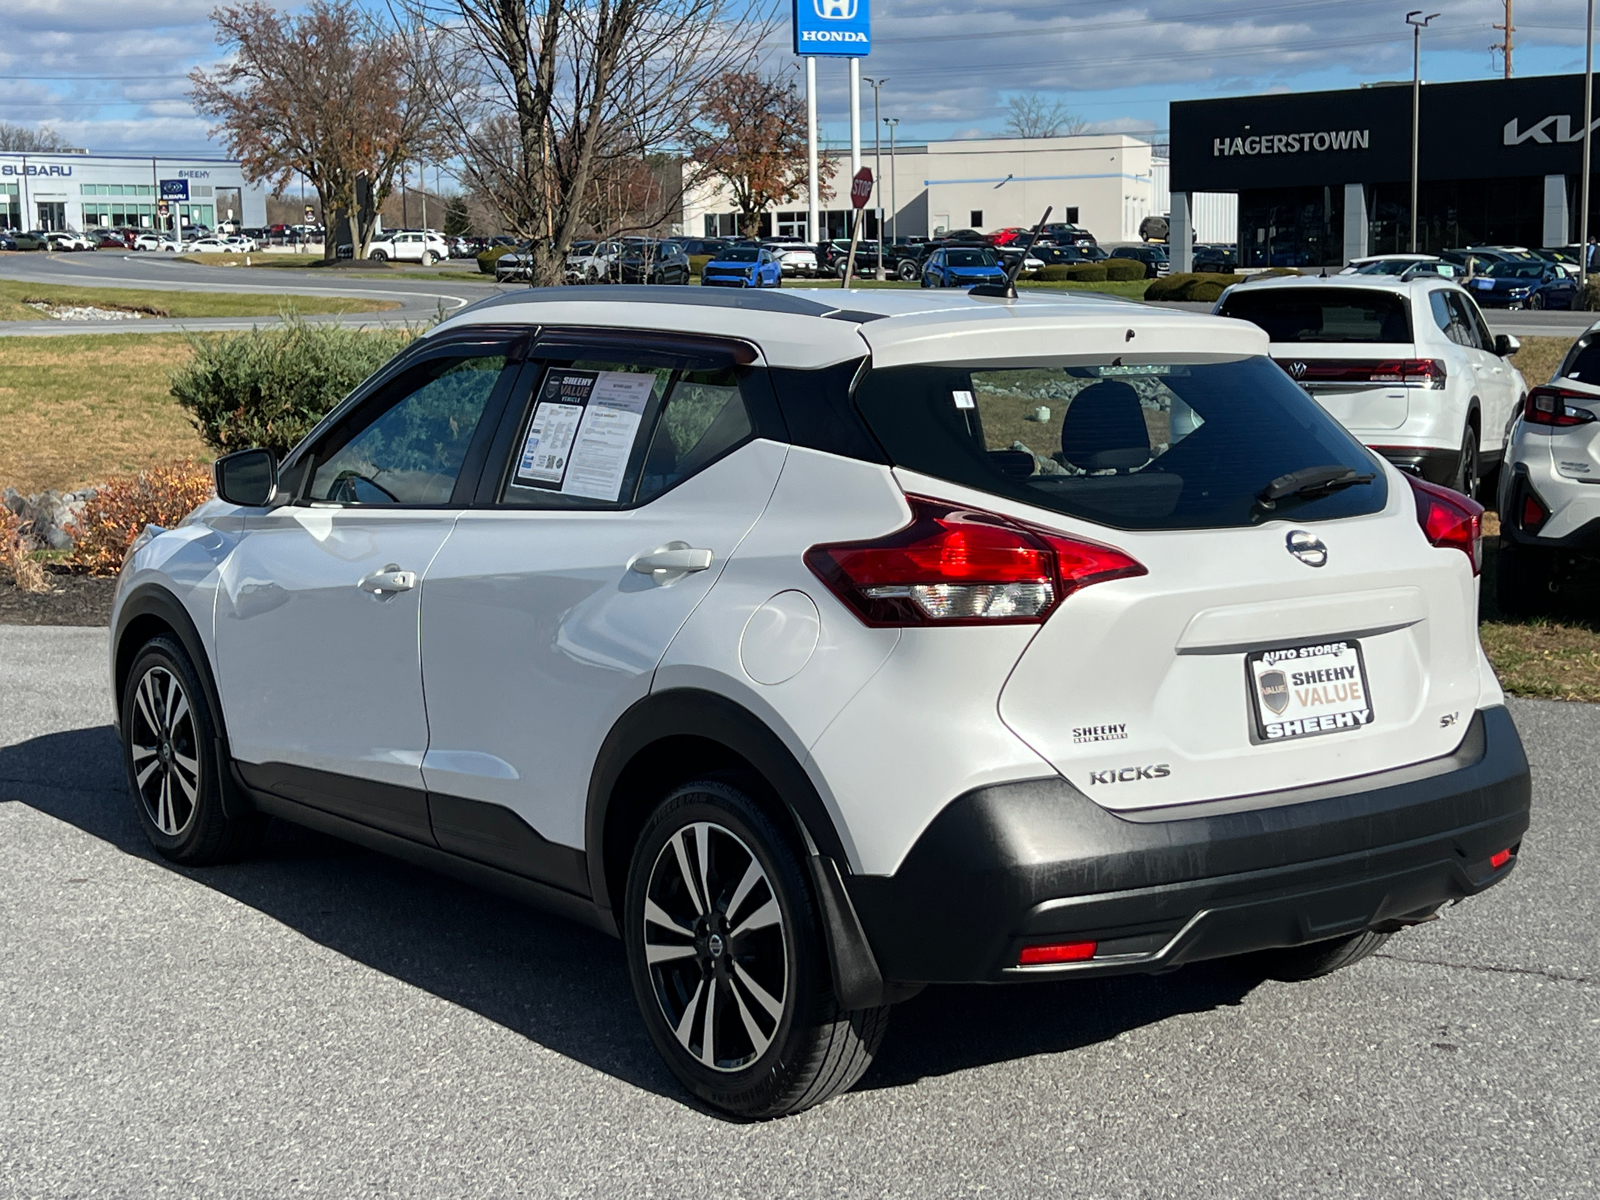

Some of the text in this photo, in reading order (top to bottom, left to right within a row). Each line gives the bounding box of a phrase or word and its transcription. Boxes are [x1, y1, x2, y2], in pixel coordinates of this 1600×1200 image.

[802, 31, 868, 43] HONDA
[1213, 129, 1369, 157] HAGERSTOWN
[1, 165, 72, 177] SUBARU
[178, 170, 210, 178] SHEEHY
[852, 179, 872, 197] STOP
[562, 376, 593, 386] SHEEHY
[560, 385, 590, 397] VALUE
[1262, 642, 1348, 662] AUTO STORES
[1291, 665, 1355, 687] SHEEHY
[1261, 685, 1287, 696] VALUE
[1294, 682, 1362, 708] VALUE
[1266, 709, 1370, 739] SHEEHY
[1440, 711, 1459, 729] SV
[1072, 723, 1127, 738] SHEEHY
[1089, 763, 1171, 786] KICKS
